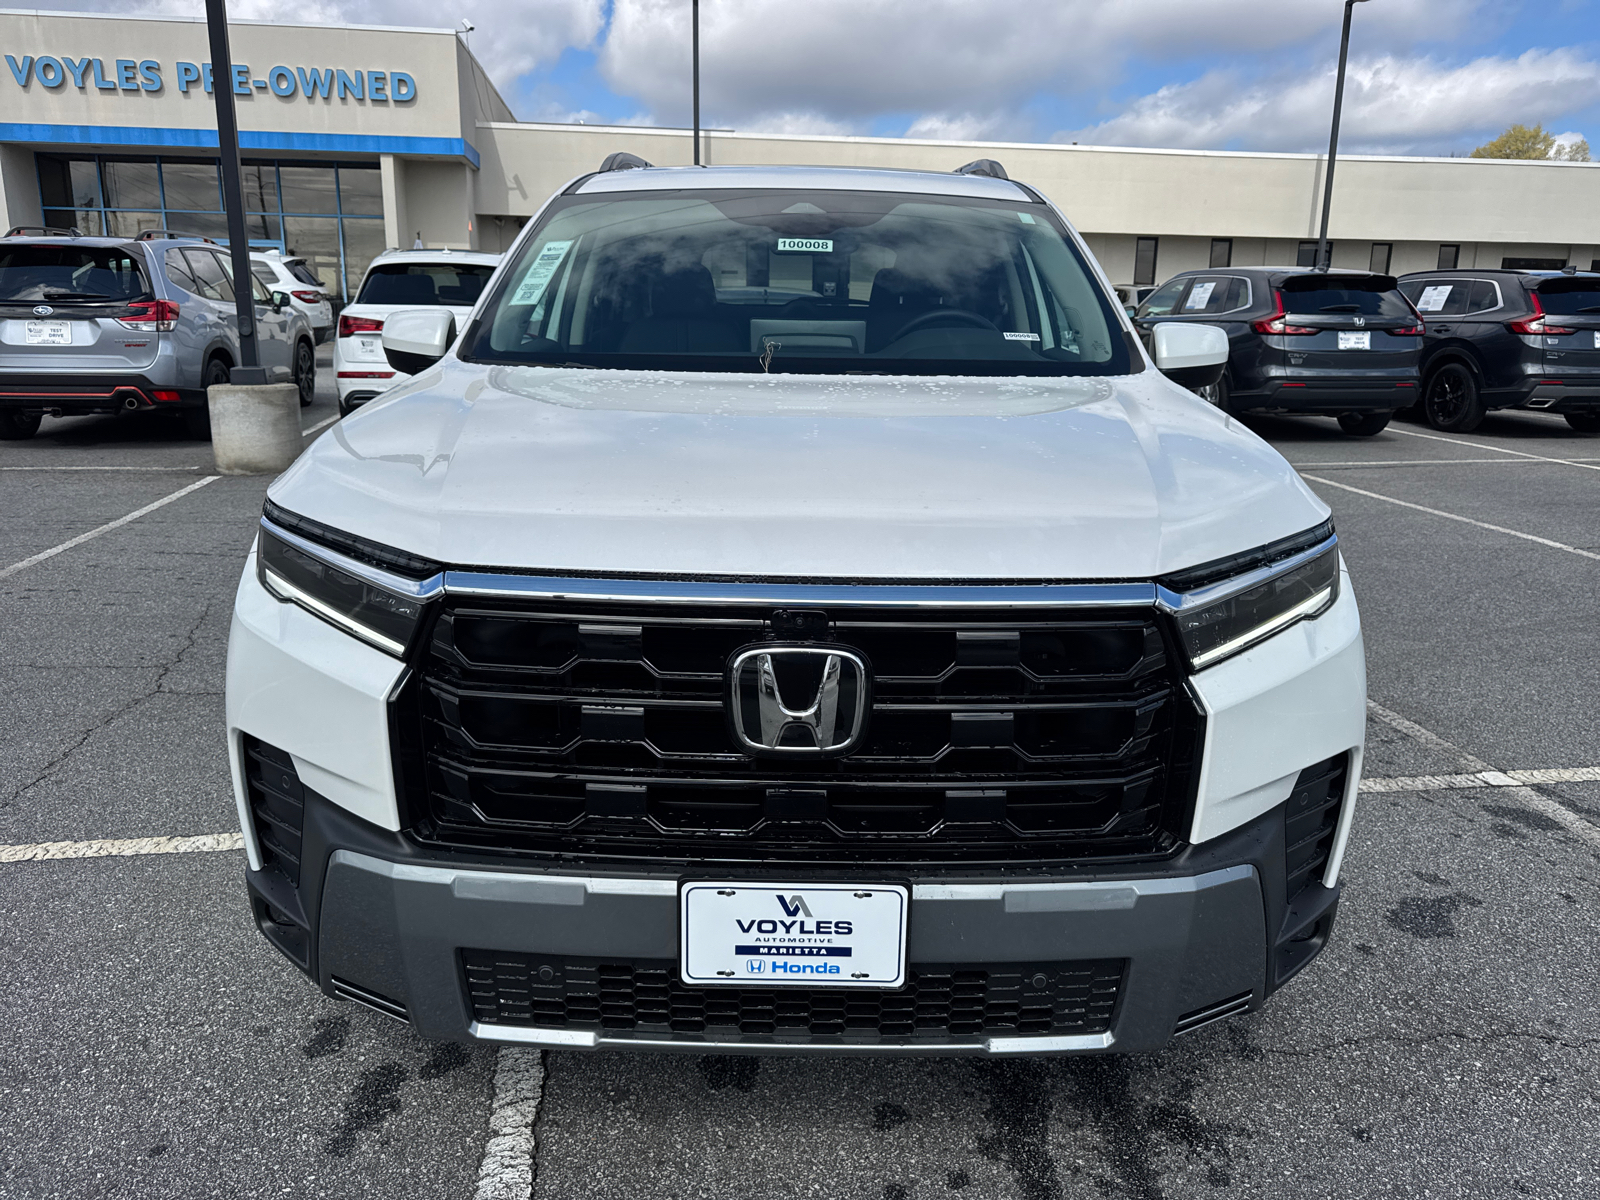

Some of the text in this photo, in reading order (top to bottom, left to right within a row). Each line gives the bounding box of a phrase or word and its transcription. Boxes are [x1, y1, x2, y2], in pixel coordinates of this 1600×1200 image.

[4, 54, 164, 92] VOYLES
[781, 240, 829, 249] 100008
[735, 919, 853, 935] VOYLES
[772, 961, 840, 974] Honda
